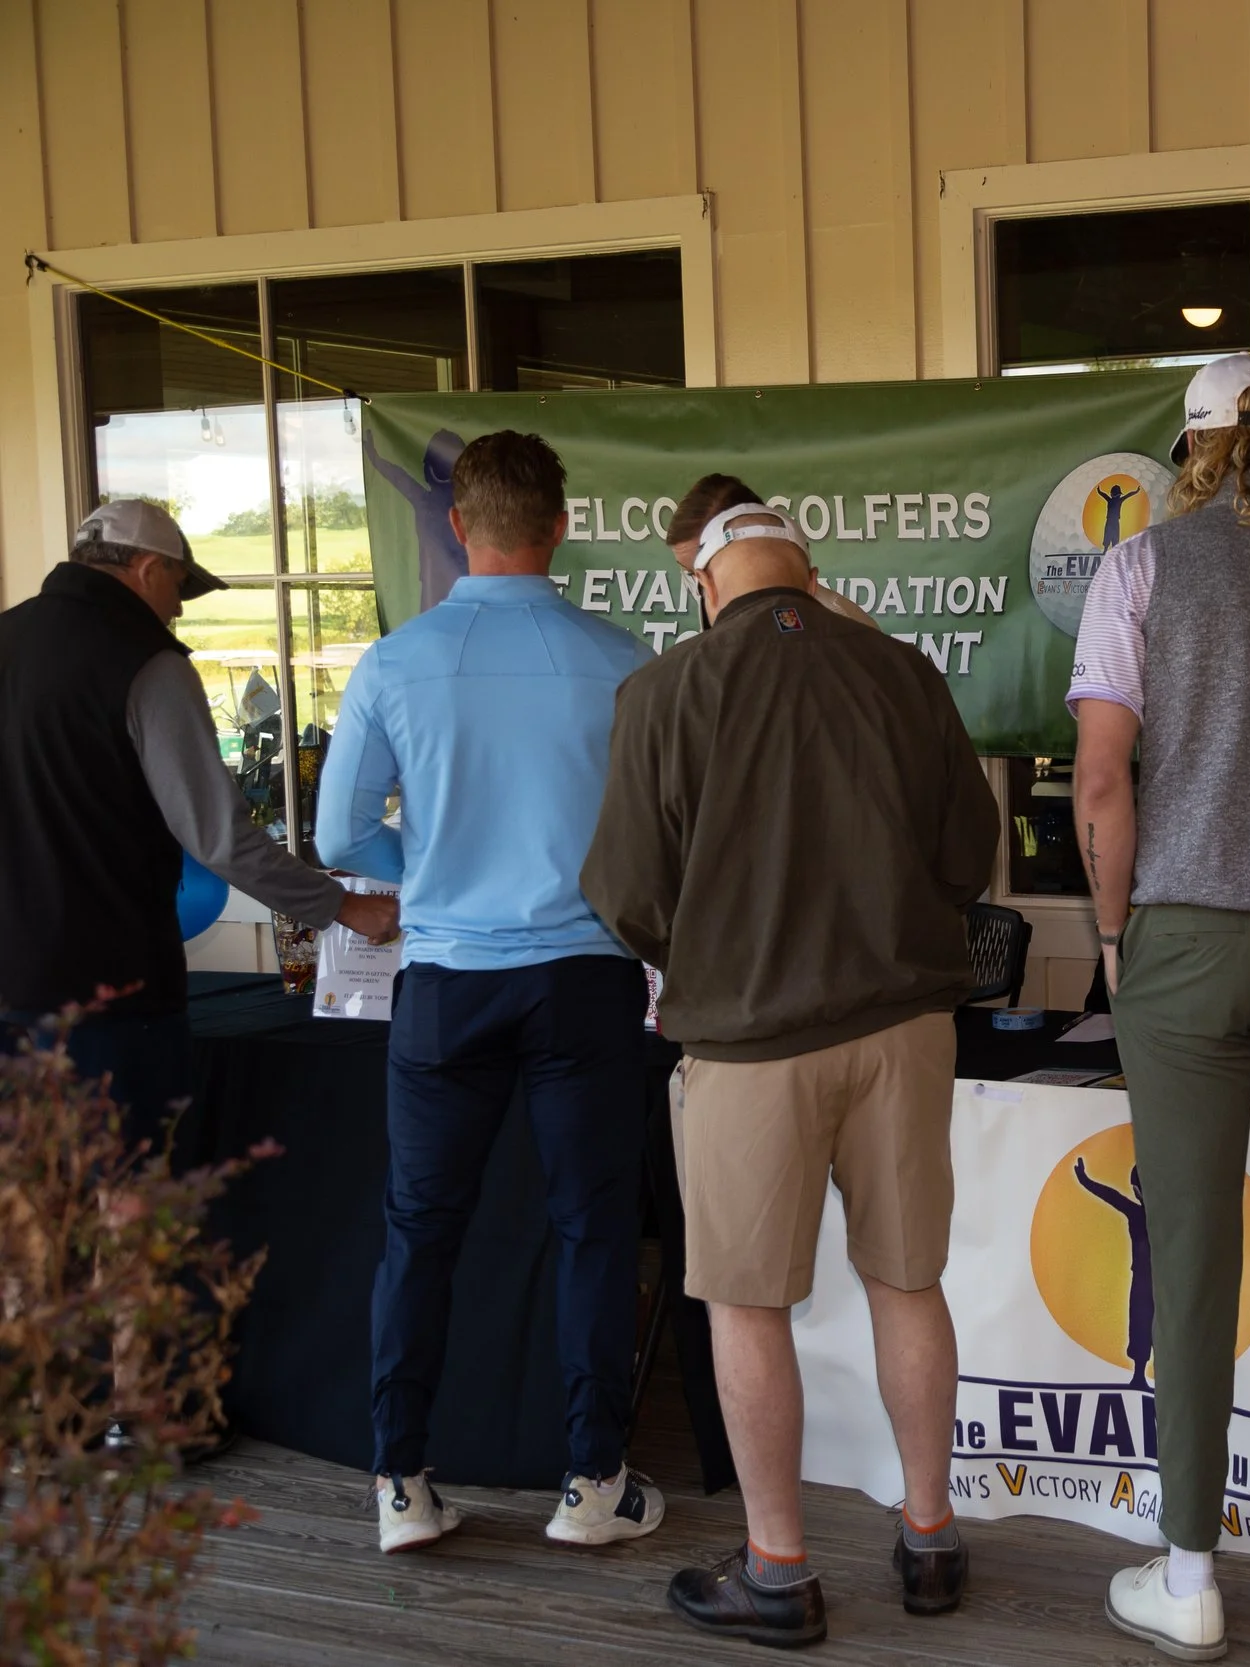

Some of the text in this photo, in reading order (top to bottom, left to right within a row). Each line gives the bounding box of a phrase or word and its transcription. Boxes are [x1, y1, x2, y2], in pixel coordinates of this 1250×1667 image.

[566, 492, 991, 542] ELCO OLFERS
[1046, 556, 1101, 577] The EVA
[1062, 580, 1089, 595] VICTOR
[817, 576, 1008, 615] DATION
[998, 1388, 1158, 1460] EVA
[948, 1474, 991, 1499] AN'S
[996, 1462, 1102, 1504] VICTORY
[1110, 1471, 1164, 1524] AGAI
